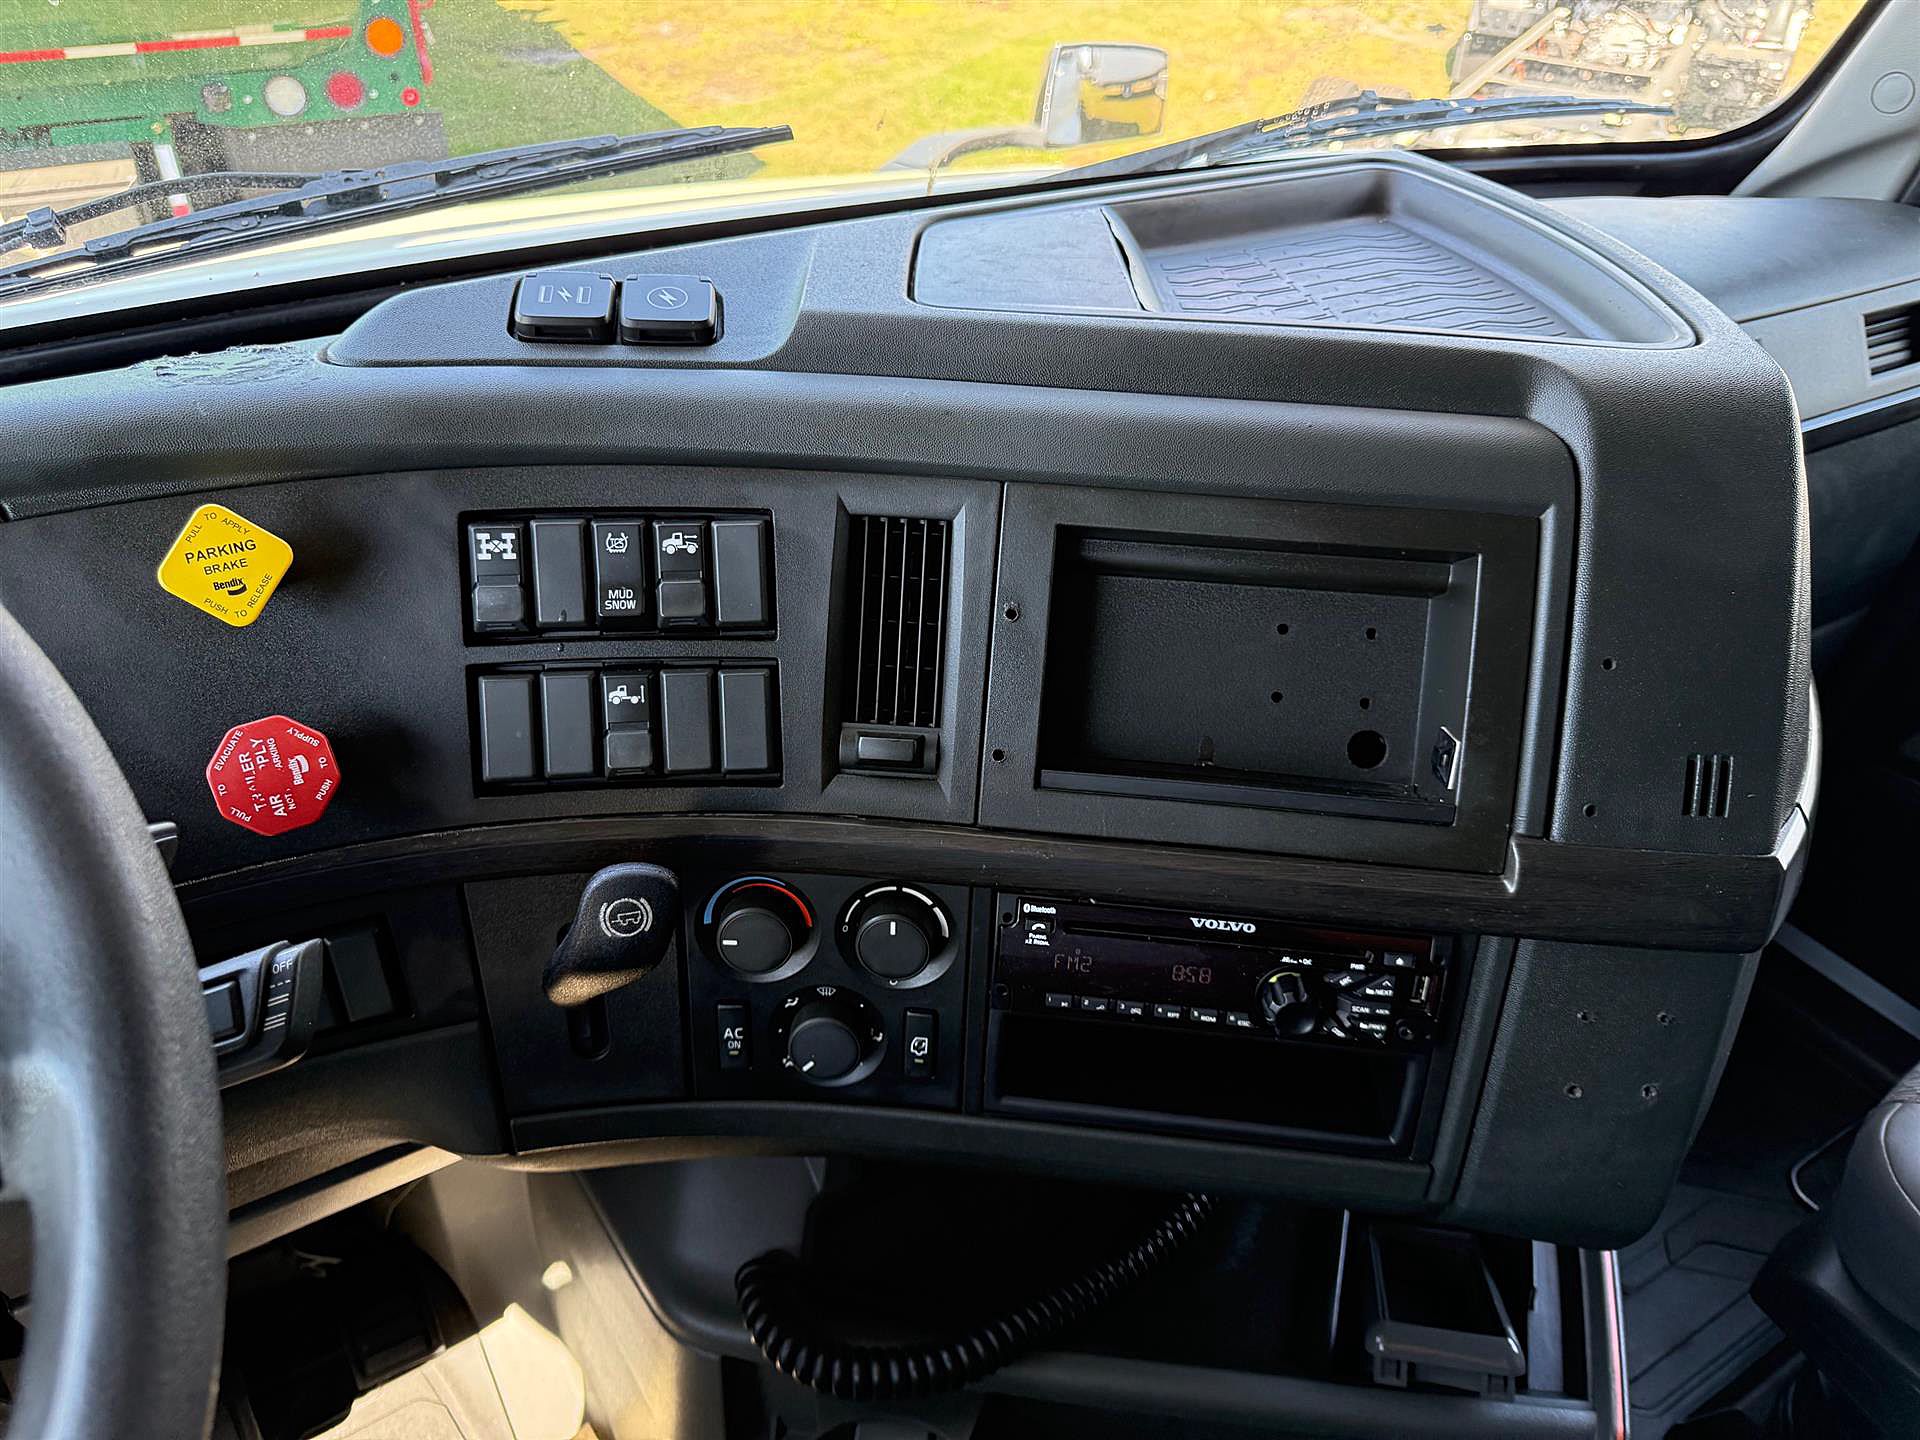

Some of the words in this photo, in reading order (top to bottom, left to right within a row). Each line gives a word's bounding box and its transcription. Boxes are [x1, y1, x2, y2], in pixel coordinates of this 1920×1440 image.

[184, 524, 202, 543] PULL
[204, 512, 217, 521] TO
[221, 517, 250, 536] APPLY
[185, 539, 257, 564] PARKING
[203, 558, 248, 575] BRAKE
[213, 577, 245, 591] Bendix
[204, 598, 229, 615] PUSH
[234, 609, 248, 619] TO
[247, 572, 273, 608] RELEASE
[608, 589, 634, 600] MUD
[604, 600, 637, 610] SNOW
[286, 727, 320, 747] SUPPLY
[213, 730, 244, 771] EVACUATE
[267, 737, 284, 771] ARKING
[318, 756, 329, 769] TO
[288, 757, 305, 786] Bendix
[217, 784, 228, 797] TO
[315, 778, 333, 801] PUSH
[269, 794, 288, 817] AIR
[284, 793, 297, 810] NOT
[230, 806, 252, 823] PULL
[1189, 917, 1257, 933] VOLVO
[272, 958, 294, 975] OFF
[723, 1027, 744, 1040] AC
[727, 1040, 741, 1049] ON
